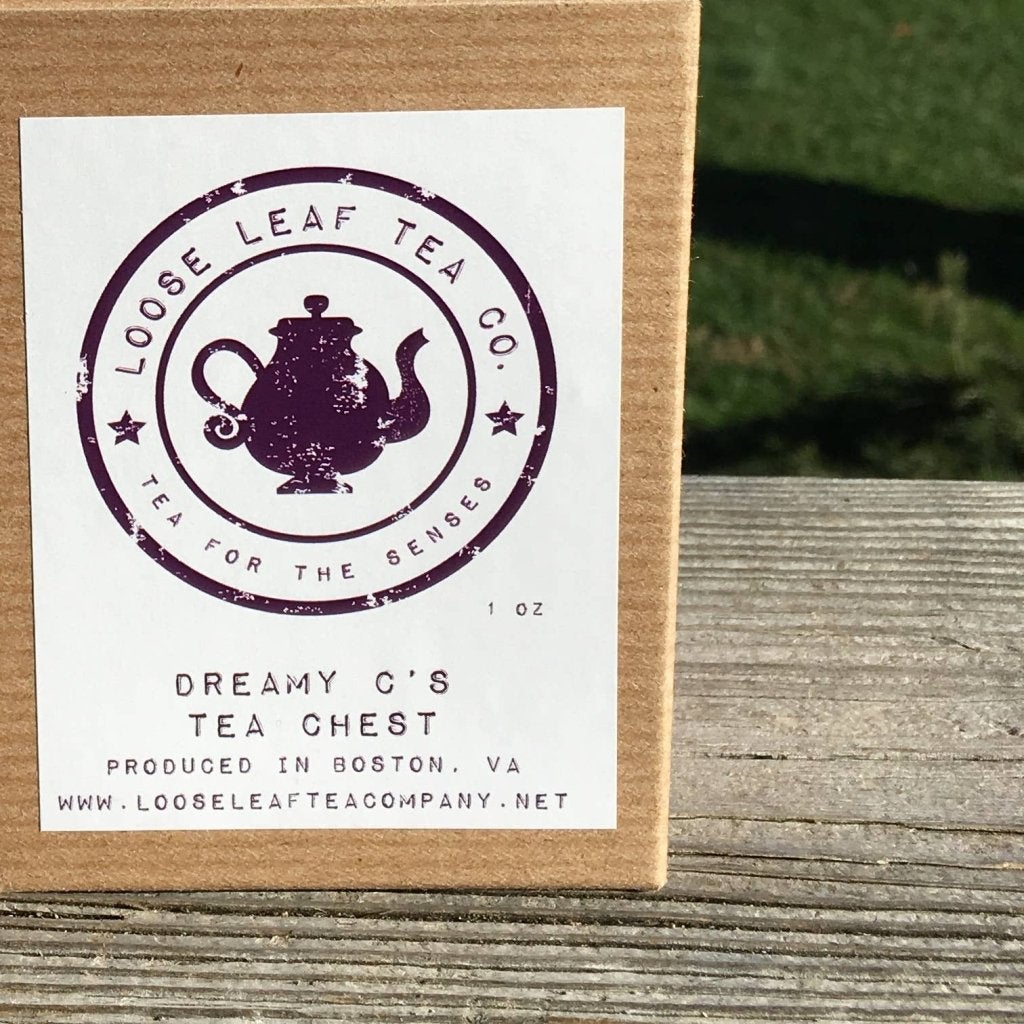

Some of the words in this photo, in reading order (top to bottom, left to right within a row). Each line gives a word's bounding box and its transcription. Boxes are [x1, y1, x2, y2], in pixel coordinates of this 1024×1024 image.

[114, 246, 212, 375] LOOSE
[235, 204, 357, 246] LEAF
[394, 217, 465, 285] TEA
[478, 307, 519, 370] CO.
[141, 473, 183, 528] TEA
[204, 538, 262, 574] FOR
[294, 562, 355, 582] THE
[385, 477, 492, 566] SENSES
[487, 601, 495, 615] 1
[515, 602, 543, 617] OZ
[175, 670, 337, 697] DREAMY
[375, 669, 450, 695] C'S
[188, 712, 265, 739] TEA
[301, 711, 437, 738] CHEST
[107, 757, 251, 776] PRODUCED
[278, 756, 309, 774] IN
[486, 756, 520, 774] VA
[57, 791, 568, 812] WWW.LOOSELEAFTEACOMPANY.NET
